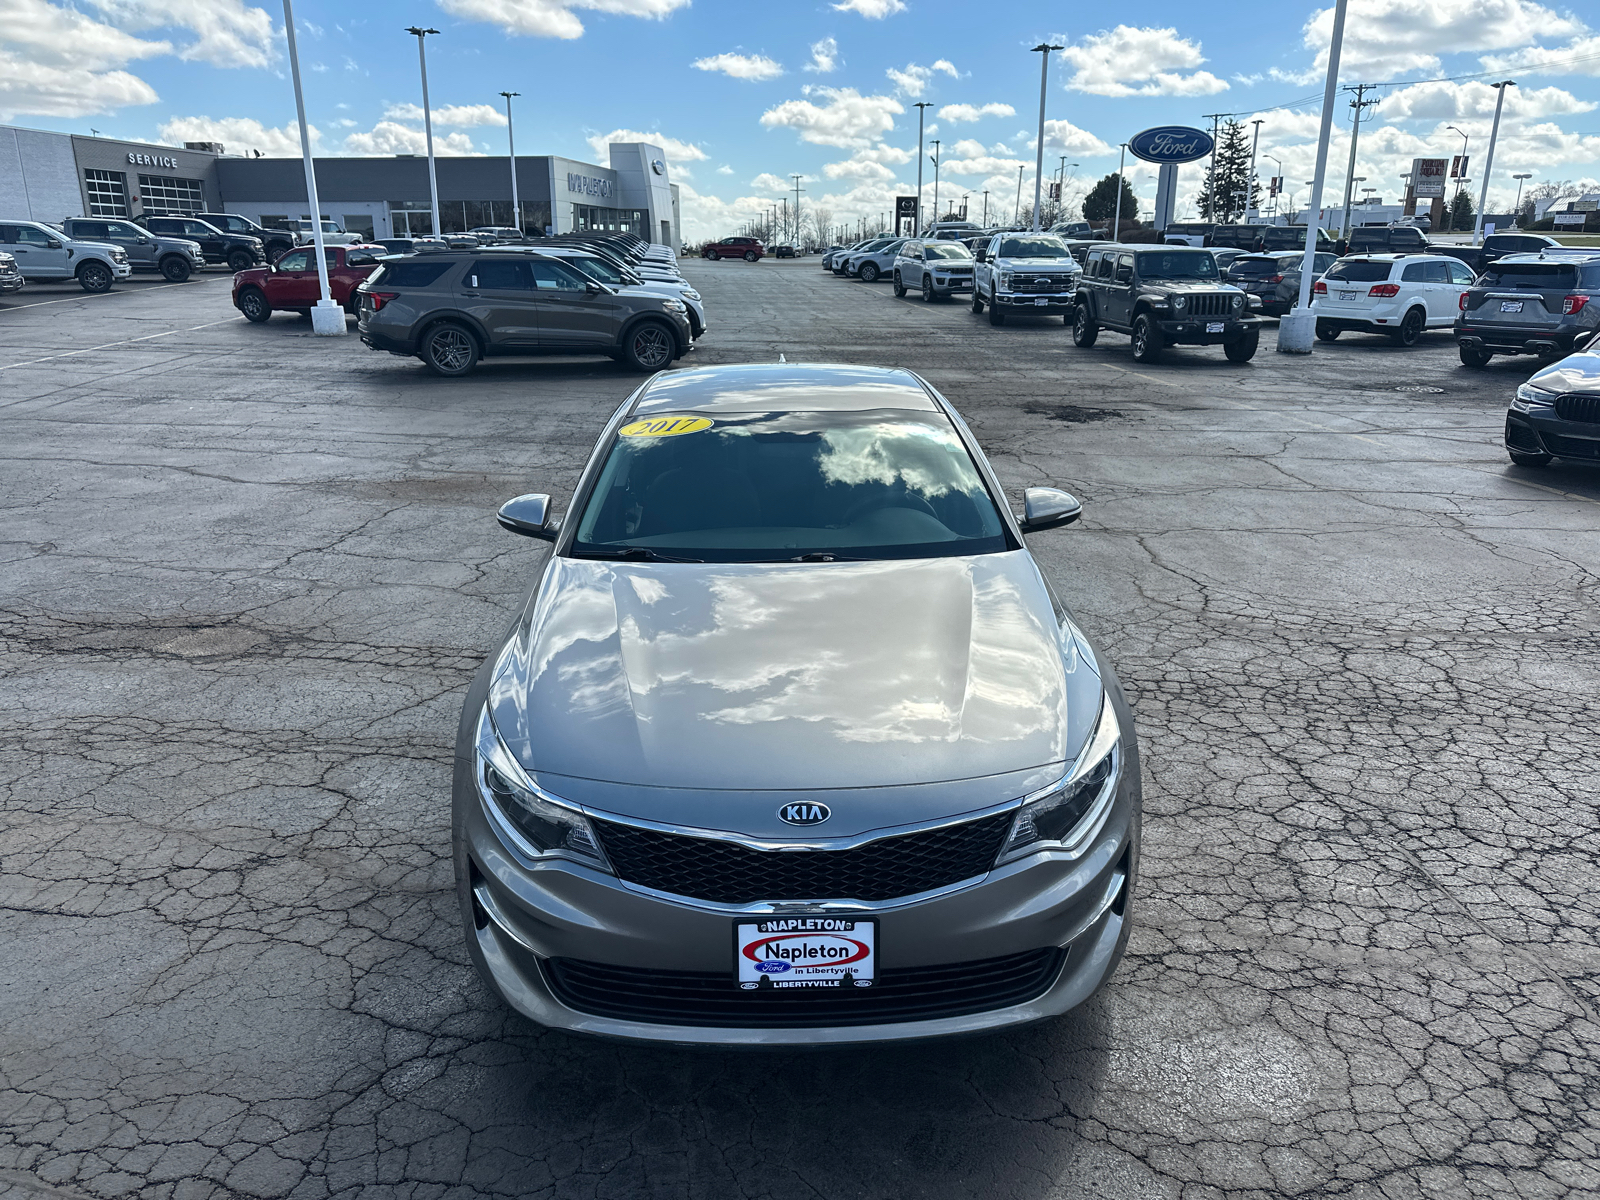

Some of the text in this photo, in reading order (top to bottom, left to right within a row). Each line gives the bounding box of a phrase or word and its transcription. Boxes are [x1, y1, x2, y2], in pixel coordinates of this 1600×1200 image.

[1148, 133, 1199, 155] Ford
[128, 152, 178, 168] SERVICE
[629, 418, 700, 435] 2017
[787, 805, 823, 820] KIA
[766, 919, 846, 932] NAPLETON
[765, 943, 849, 962] Napleton
[762, 962, 785, 972] Ford
[795, 967, 859, 975] in Libertyville
[773, 980, 840, 988] LIBERTYVILLE
